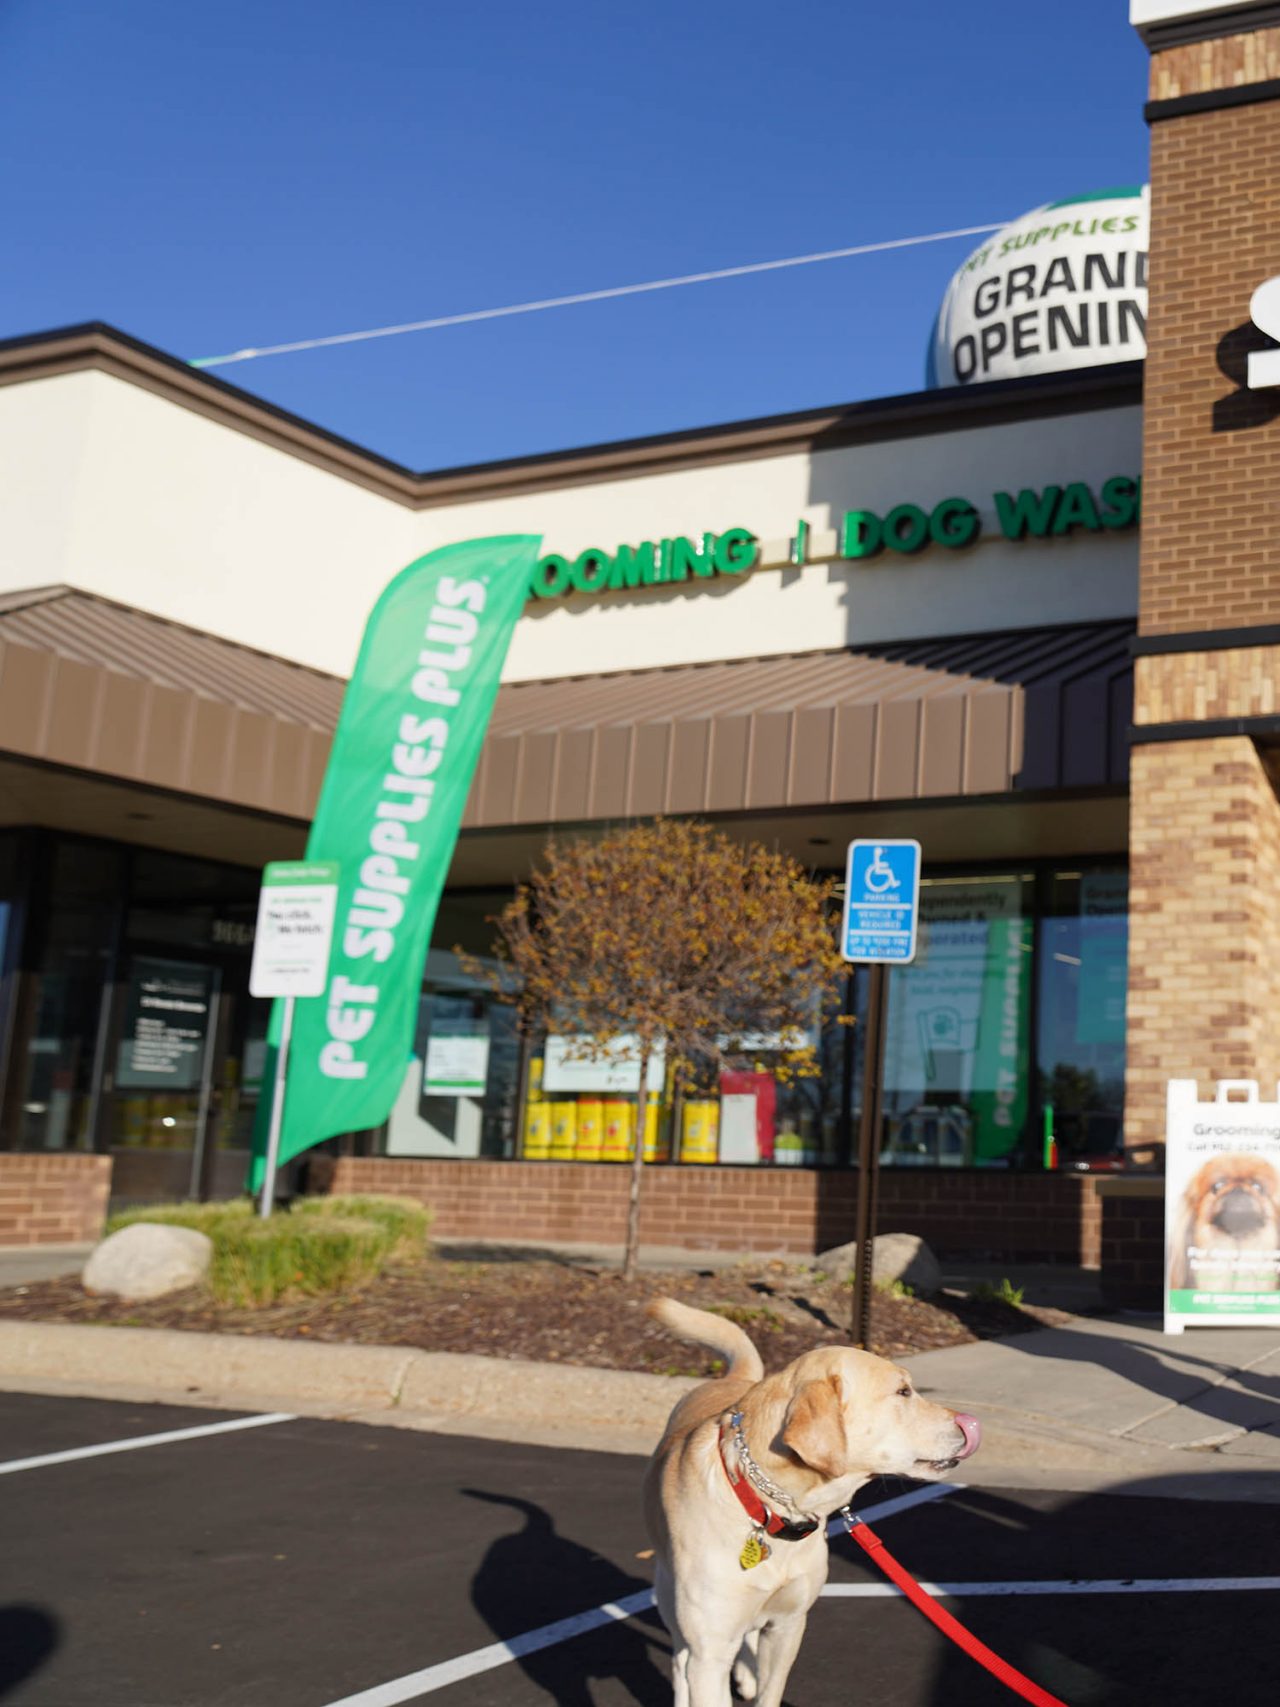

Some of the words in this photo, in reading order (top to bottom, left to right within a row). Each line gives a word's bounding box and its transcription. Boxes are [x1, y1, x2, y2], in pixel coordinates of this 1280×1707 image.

[1000, 215, 1140, 257] SUPPLIES
[840, 497, 981, 561] DOG
[993, 474, 1142, 540] WAS
[411, 576, 488, 708] PLUS
[342, 713, 450, 964] SUPPLIES
[319, 975, 380, 1082] PET
